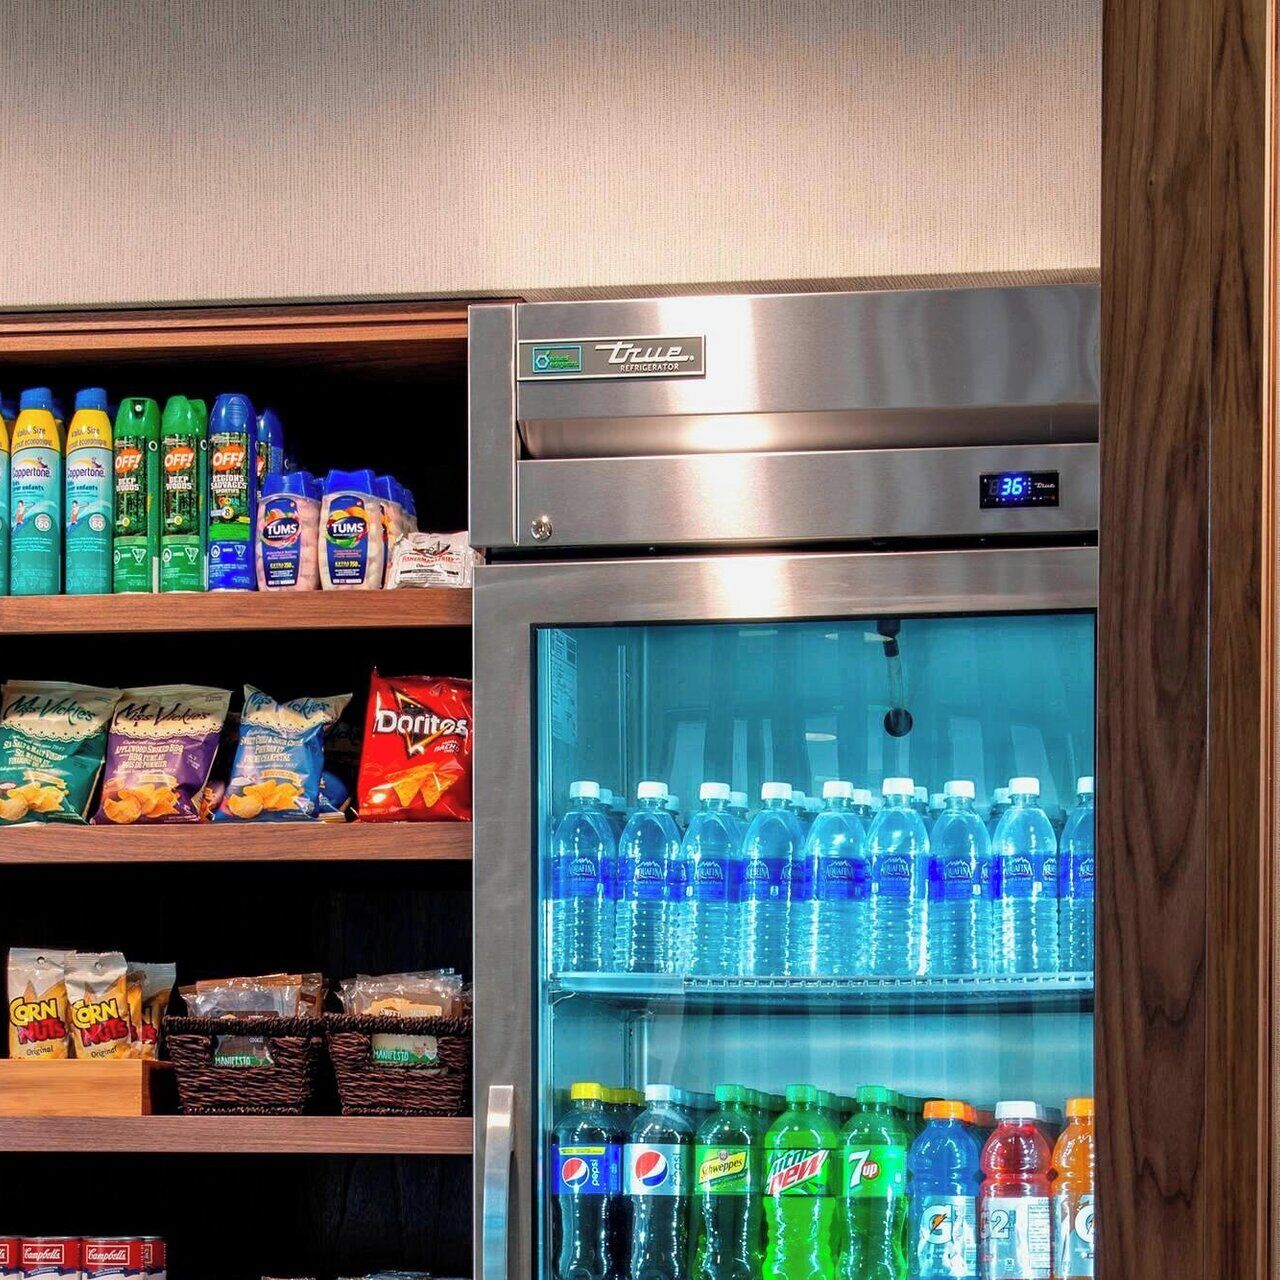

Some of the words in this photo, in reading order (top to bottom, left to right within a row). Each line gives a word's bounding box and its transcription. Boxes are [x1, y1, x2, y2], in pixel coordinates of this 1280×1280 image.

[620, 363, 679, 372] REFRIGERATOR
[33, 427, 46, 436] Size
[87, 427, 100, 436] Size
[115, 454, 142, 469] OFF!
[164, 452, 194, 468] OFF!
[212, 451, 245, 469] OFF!
[166, 483, 192, 491] WOODS
[169, 476, 189, 484] DEEP
[1001, 477, 1022, 495] 36
[267, 524, 297, 536] TUMS
[332, 523, 364, 534] TUMS
[39, 698, 96, 726] Vickie's
[116, 703, 154, 727] Miss
[155, 703, 210, 726] Vickie's
[376, 710, 467, 736] Doritos
[9, 997, 58, 1027] CORN
[71, 998, 120, 1029] CORN
[17, 1017, 69, 1045] NUTS
[81, 1017, 130, 1047] NUTS
[26, 1045, 54, 1057] Original
[90, 1046, 118, 1058] Original
[590, 1158, 600, 1187] pepsi
[702, 1157, 743, 1178] Schweppes
[24, 1247, 61, 1262] Campbell's
[88, 1248, 127, 1262] Campbell's
